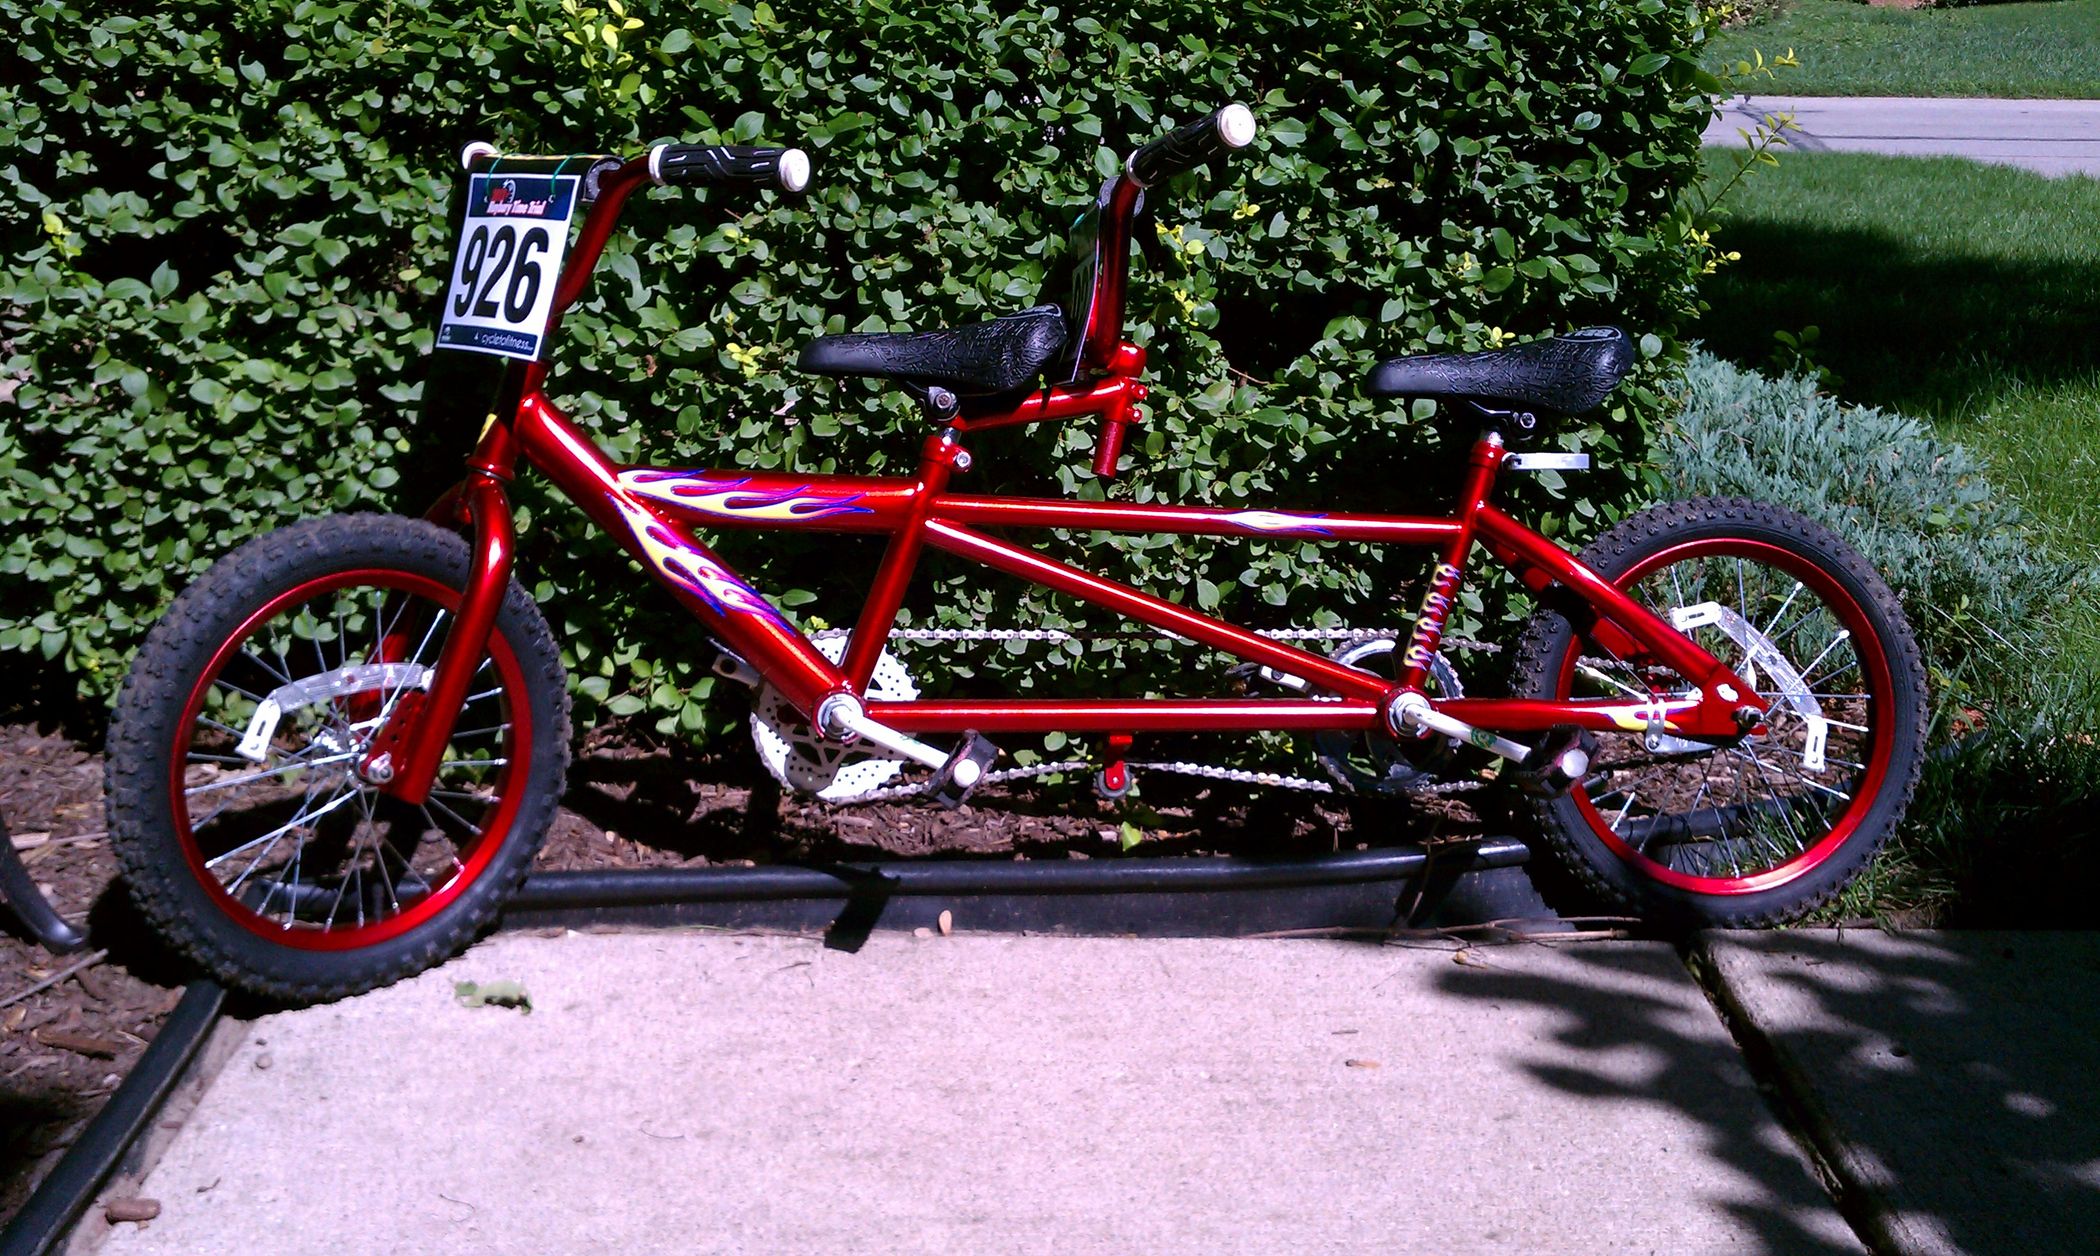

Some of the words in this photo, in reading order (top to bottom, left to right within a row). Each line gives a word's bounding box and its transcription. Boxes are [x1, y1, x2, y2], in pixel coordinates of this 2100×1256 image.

[510, 199, 529, 215] Time
[527, 200, 547, 216] Trial
[454, 224, 550, 324] 926
